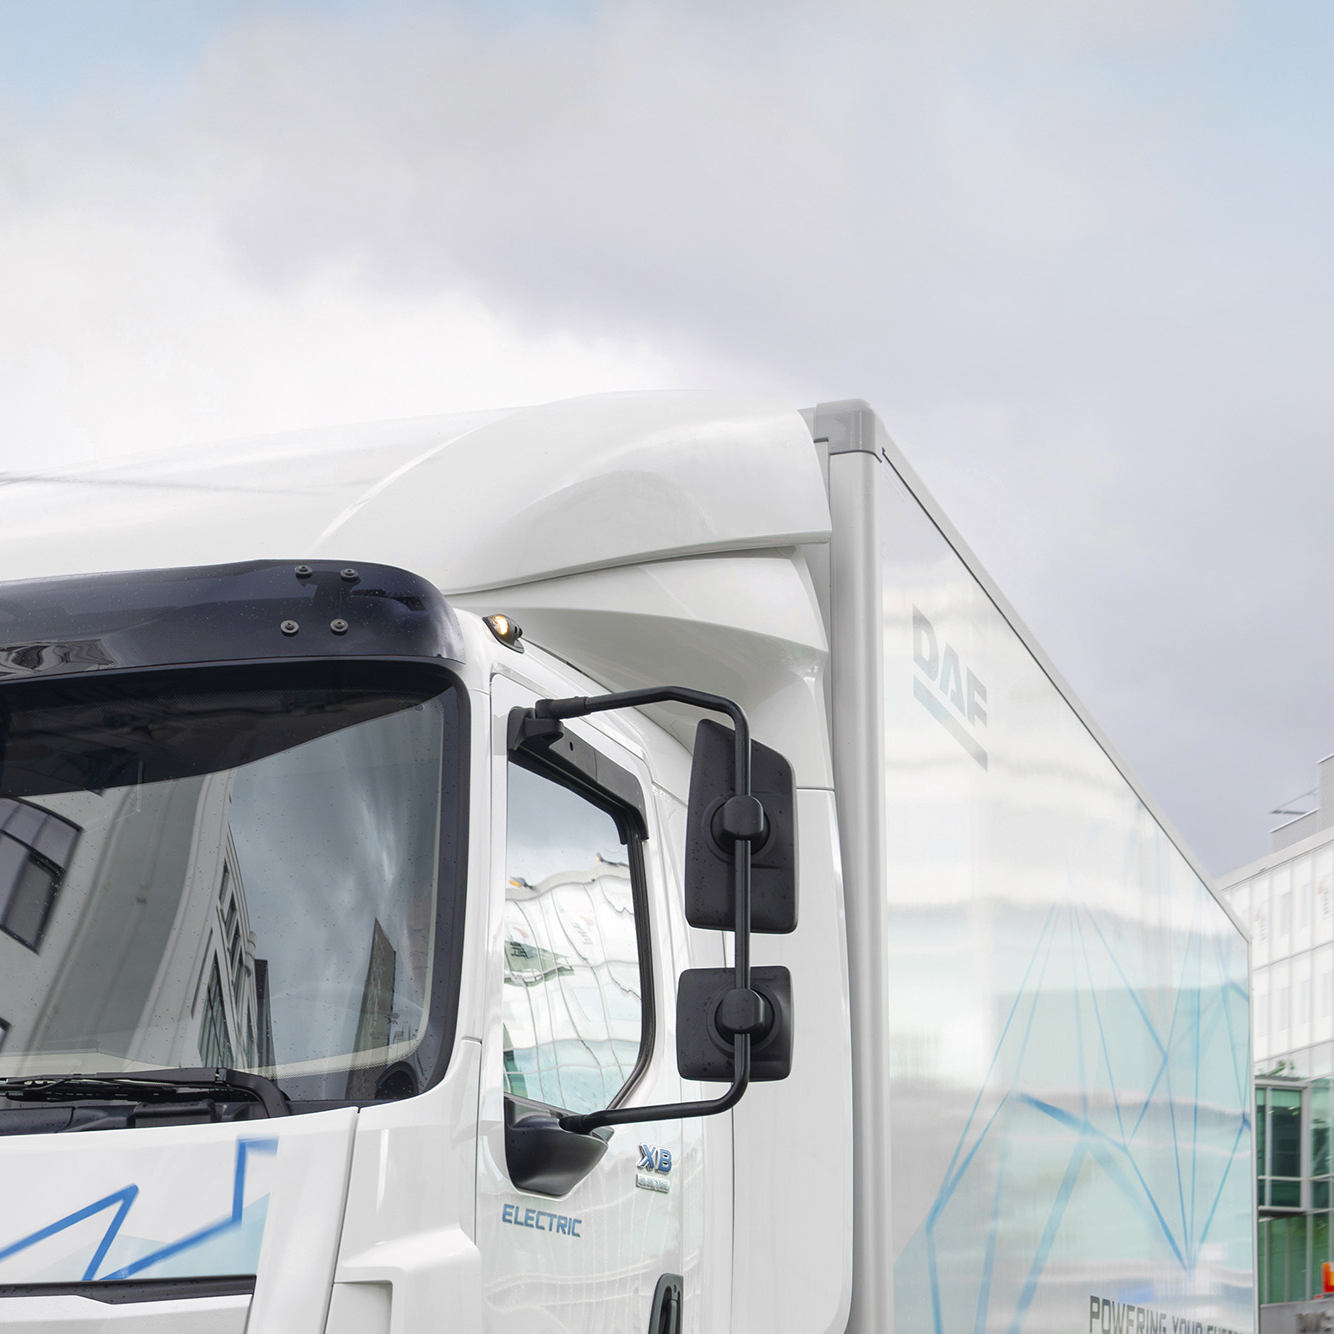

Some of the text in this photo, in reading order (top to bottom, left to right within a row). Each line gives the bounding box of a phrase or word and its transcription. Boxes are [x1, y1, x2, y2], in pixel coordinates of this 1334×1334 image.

[912, 603, 987, 728] DAF
[636, 1143, 673, 1175] XB
[502, 1203, 583, 1238] ELECTRIC
